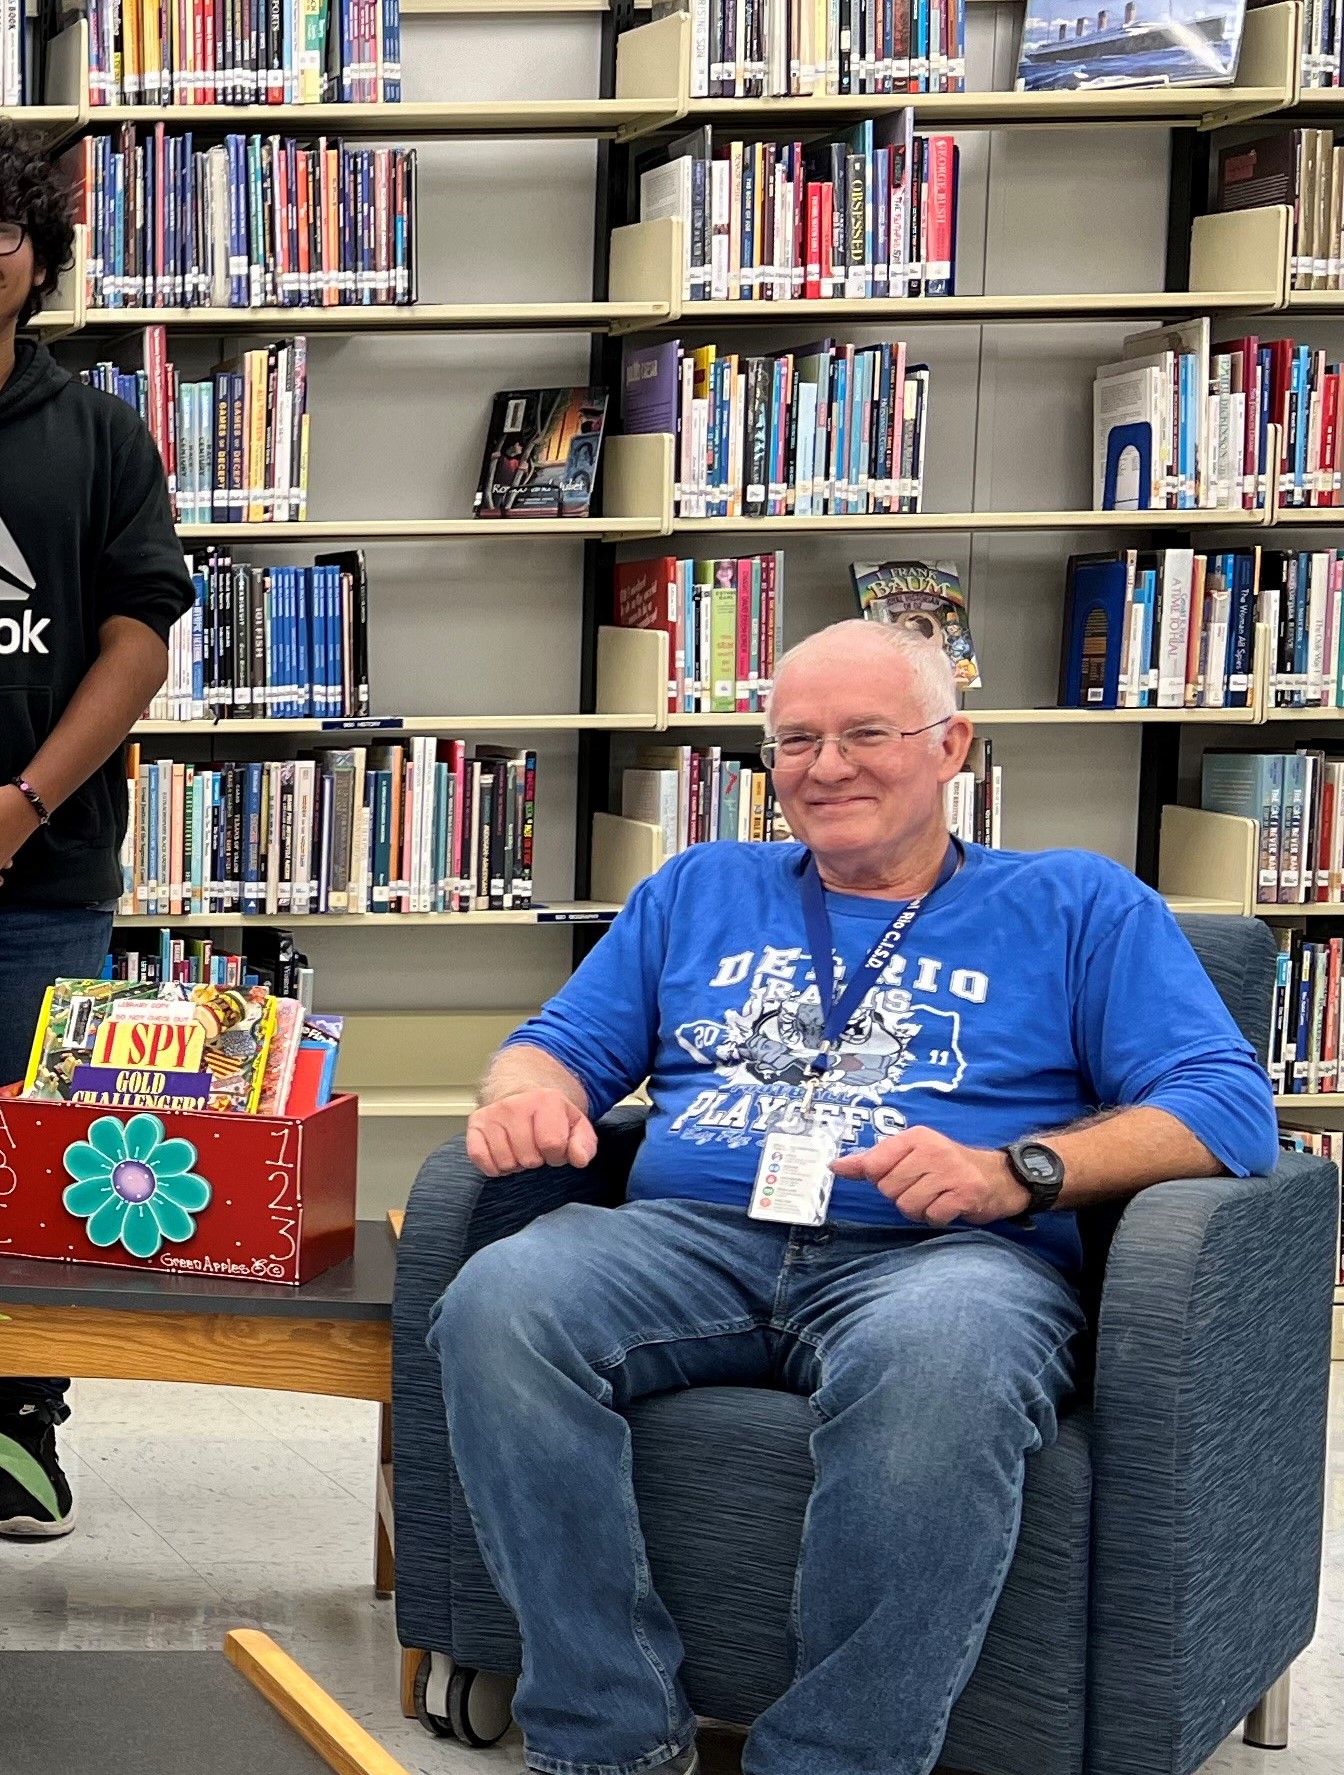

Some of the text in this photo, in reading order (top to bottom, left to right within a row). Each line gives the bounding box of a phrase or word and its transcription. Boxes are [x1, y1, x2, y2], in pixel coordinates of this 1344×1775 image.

[8, 7, 17, 31] BOOK
[271, 0, 280, 31] PORTS
[697, 39, 708, 58] SON
[935, 140, 947, 224] GEORGE BUSH
[851, 180, 863, 262] OBSESSED
[219, 402, 227, 437] GAMES
[233, 401, 241, 436] GAMES
[1218, 398, 1229, 459] DICKINSON
[218, 451, 227, 488] DECEPT
[233, 451, 242, 488] DECEPT
[891, 567, 937, 580] FRANK
[867, 576, 951, 598] BAUM
[1240, 589, 1248, 603] The
[1169, 587, 1179, 614] TIME
[255, 607, 263, 658] 101 FISH
[1169, 617, 1179, 629] TO
[1238, 605, 1247, 634] Woman
[1315, 620, 1323, 633] The
[1169, 631, 1180, 657] HEAL
[1235, 649, 1245, 669] Spies
[1272, 789, 1280, 802] THE
[1293, 789, 1301, 802] THE
[1271, 805, 1279, 819] CAT
[1292, 805, 1300, 819] CAT
[1270, 828, 1279, 853] NEVER
[1291, 828, 1300, 853] NEVER
[864, 910, 916, 970] Rio C.I.S.D.
[709, 945, 847, 987] DE
[762, 977, 913, 1012] RAS
[100, 1021, 197, 1068] I SPY
[693, 1025, 720, 1049] 20
[929, 1049, 950, 1066] 11
[115, 1070, 166, 1095] GOLD
[265, 1128, 295, 1168] 1
[267, 1171, 294, 1211] 2
[269, 1215, 297, 1261] 3
